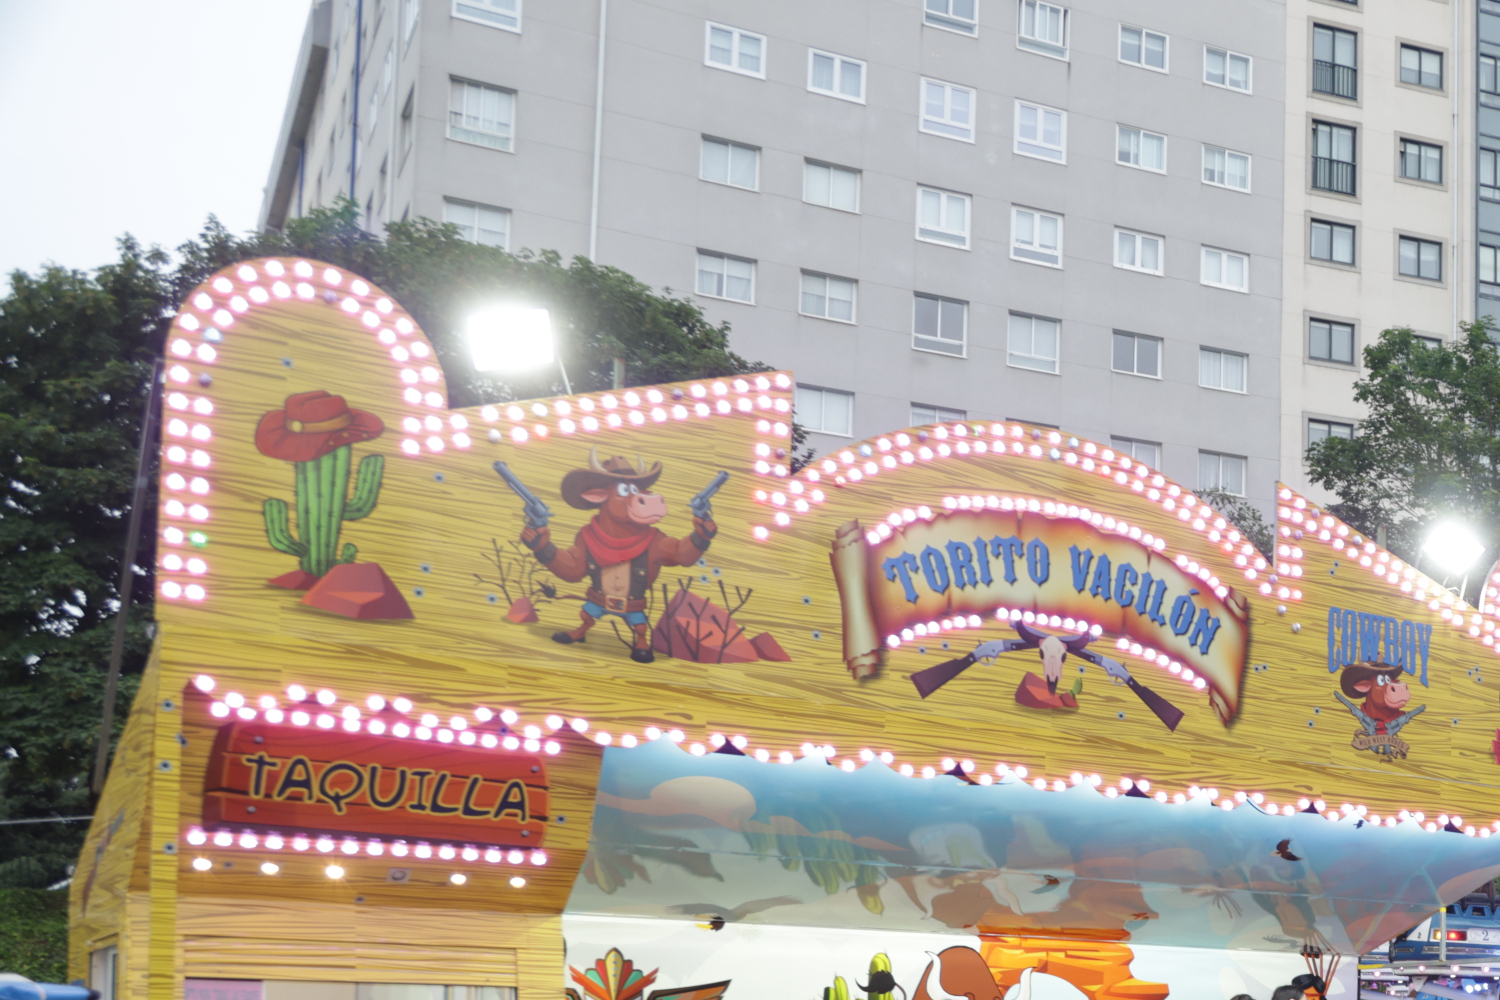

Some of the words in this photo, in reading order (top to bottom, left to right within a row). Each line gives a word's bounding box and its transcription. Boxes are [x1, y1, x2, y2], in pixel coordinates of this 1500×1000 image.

[881, 534, 1050, 604] TORITO
[1068, 543, 1221, 655] VACILÓN
[1326, 606, 1432, 688] COWBOY
[243, 752, 529, 823] TAQUILLA
[1481, 930, 1490, 941] 2
